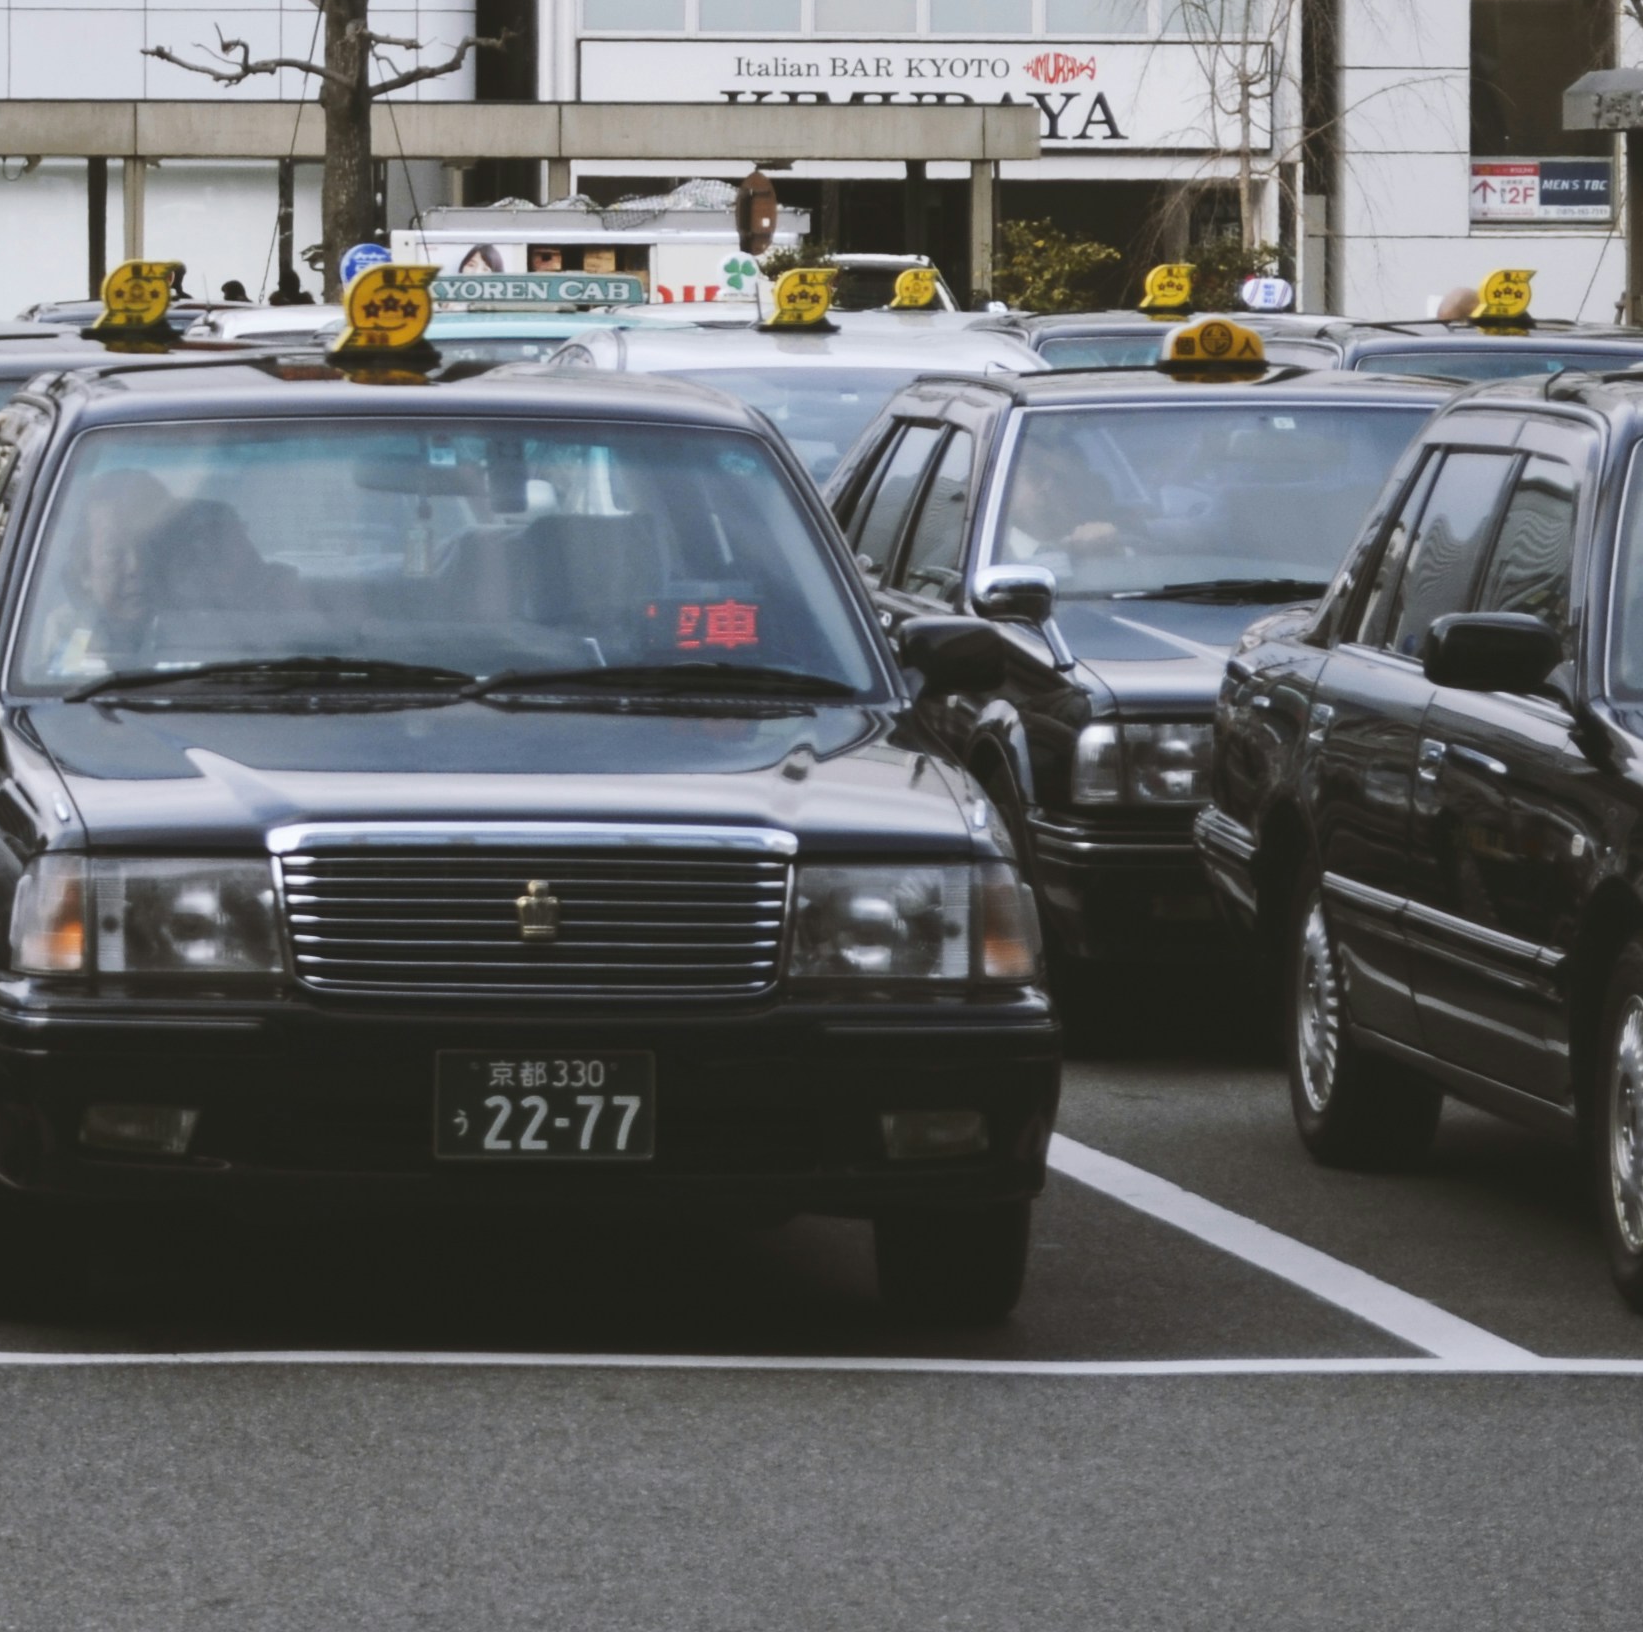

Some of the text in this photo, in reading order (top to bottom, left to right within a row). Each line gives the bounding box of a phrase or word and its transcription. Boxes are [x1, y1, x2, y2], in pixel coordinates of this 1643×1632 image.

[735, 57, 1010, 78] Italian BAR KYOTO
[1508, 187, 1535, 204] 2F
[1542, 180, 1608, 191] MEN'S TBC
[560, 280, 629, 300] CAB
[1238, 338, 1261, 356] 人
[489, 1060, 604, 1087] 京都 330
[454, 1095, 641, 1150] う 22-77
